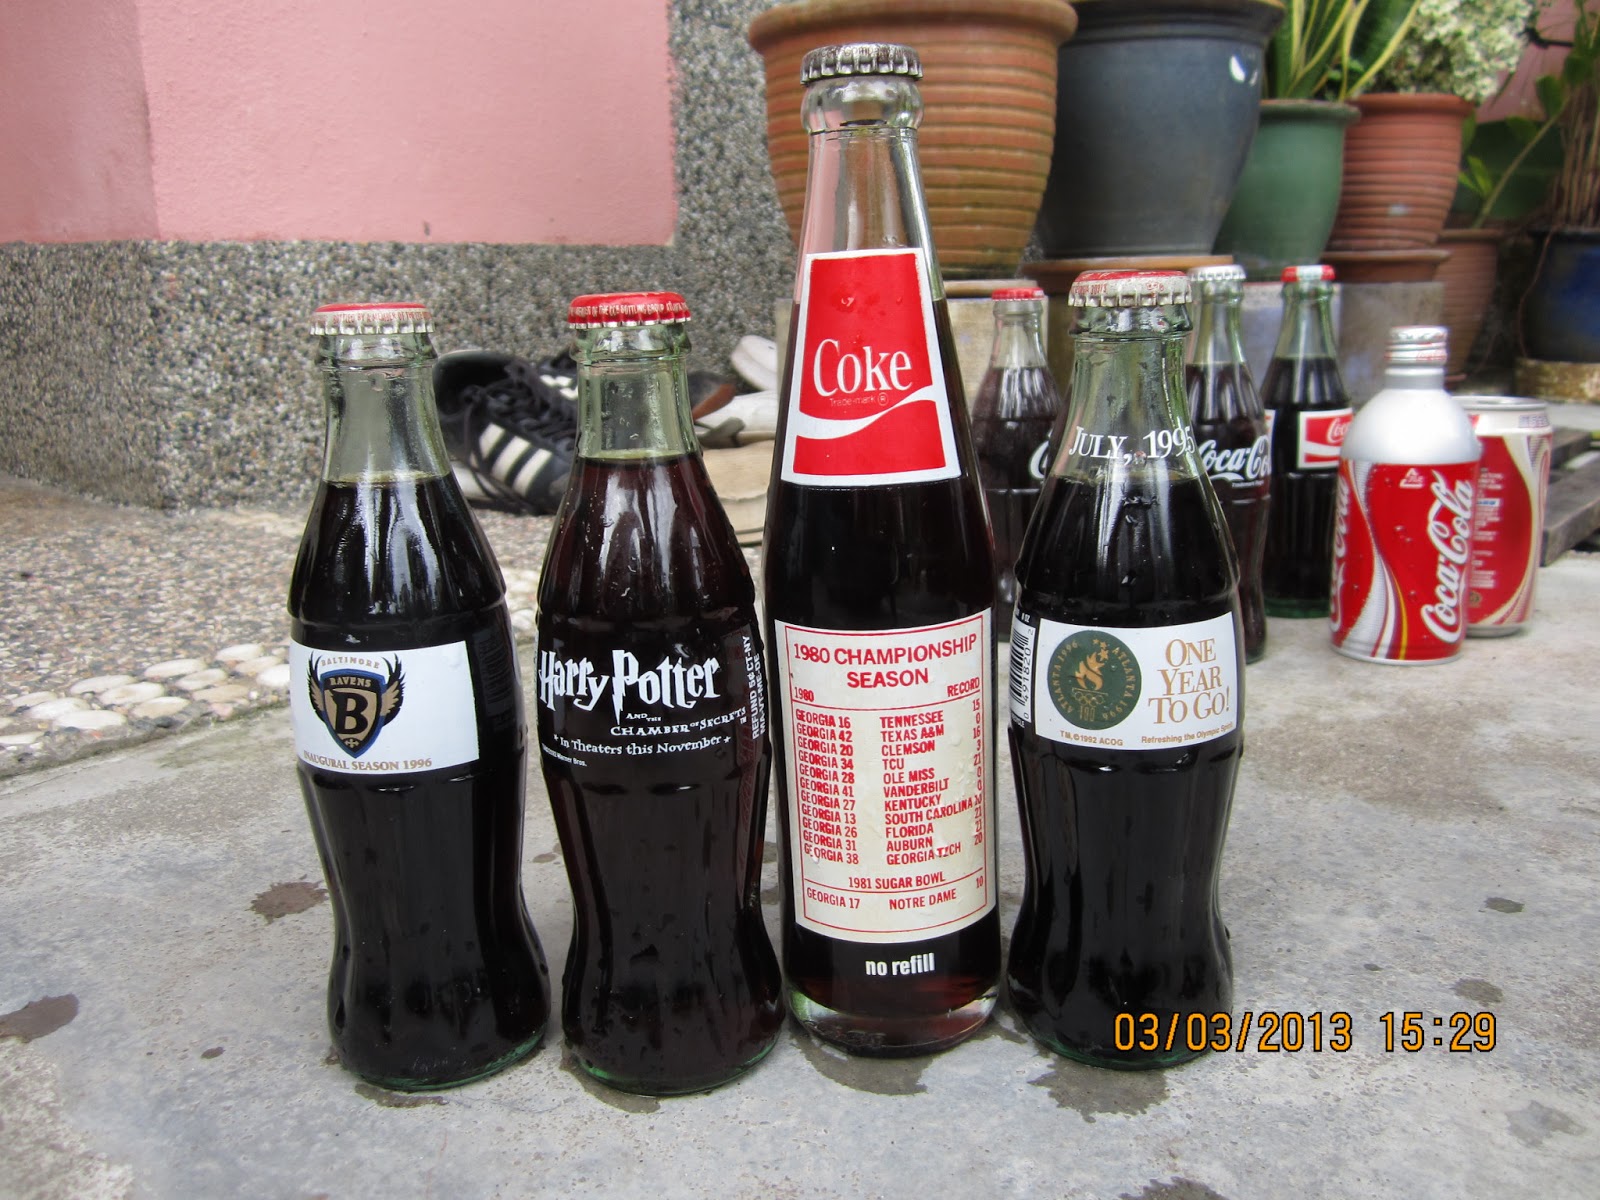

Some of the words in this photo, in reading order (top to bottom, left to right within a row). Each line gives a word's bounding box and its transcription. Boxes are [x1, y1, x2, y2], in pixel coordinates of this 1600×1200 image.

[813, 338, 912, 397] Coke
[1068, 425, 1129, 466] JULY,
[1142, 426, 1196, 459] 1995
[1420, 469, 1473, 644] Coca-Cola
[742, 635, 754, 671] CT-NY
[793, 643, 830, 664] 1980
[833, 633, 977, 665] CHAMPIONSHIP
[1057, 640, 1079, 663] 1996
[1164, 638, 1217, 668] ONE
[321, 656, 381, 670] BALTIMORE
[1111, 646, 1137, 699] ATLANTA
[329, 676, 373, 689] RAVENS
[538, 650, 610, 711] Harry
[611, 649, 721, 726] Potter
[794, 686, 814, 702] 1980
[946, 677, 980, 698] RECORD
[846, 667, 929, 689] SEASON
[1052, 663, 1074, 714] ATLANTA
[1157, 665, 1223, 697] YEAR
[331, 690, 369, 735] B
[749, 689, 760, 740] REFUND
[1192, 686, 1231, 720] GO!
[610, 724, 690, 736] CHAMBER
[699, 706, 747, 731] SECRETS
[626, 712, 648, 721] AND
[795, 708, 836, 728] GEORGIA
[838, 716, 851, 729] 16
[879, 710, 944, 729] TENNESSEE
[796, 722, 837, 741] GEORGIA
[838, 730, 853, 743] 42
[880, 728, 918, 743] TEXAS
[920, 724, 944, 740] A&M
[1098, 737, 1124, 747] ACOG
[1141, 735, 1183, 744] Refreshing
[1184, 733, 1195, 741] the
[1196, 728, 1220, 740] Olympic
[560, 737, 570, 749] In
[571, 739, 623, 756] Theaters
[626, 742, 653, 756] this
[656, 735, 722, 754] November
[797, 735, 838, 755] GEORGIA
[839, 743, 854, 757] 20
[881, 740, 935, 757] CLEMSON
[351, 760, 400, 771] SEASON
[402, 757, 433, 770] 1996
[798, 749, 838, 769] GEORGIA
[840, 757, 854, 770] 34
[882, 758, 904, 771] TCU
[799, 763, 840, 782] GEORGIA
[841, 771, 855, 784] 28
[883, 772, 905, 785] OLE
[908, 767, 935, 783] MISS
[800, 776, 840, 796] GEORGIA
[842, 785, 854, 798] 41
[883, 777, 950, 799] VANDERBILT
[801, 789, 841, 809] GEORGIA
[842, 799, 856, 811] 27
[884, 793, 941, 812] KENTUCKY
[801, 803, 842, 823] GEORGIA
[844, 812, 857, 825] 13
[885, 810, 923, 826] SOUTH
[925, 797, 973, 821] CAROLINA
[802, 816, 842, 836] GEORGIA
[844, 826, 858, 838] 26
[885, 822, 934, 839] FLORIDA
[803, 829, 843, 850] GEORGIA
[845, 839, 857, 852] 31
[886, 836, 933, 852] AUBURN
[846, 852, 859, 865] 38
[886, 849, 935, 866] GEORGIA
[848, 876, 872, 889] 1981
[875, 876, 913, 890] SUGAR
[915, 871, 946, 887] BOWL
[806, 887, 846, 908] GEORGIA
[849, 898, 861, 910] 17
[889, 896, 926, 911] NOTRE
[928, 888, 957, 906] DAME
[975, 875, 984, 889] 10
[865, 960, 888, 976] no
[891, 952, 936, 976] refill
